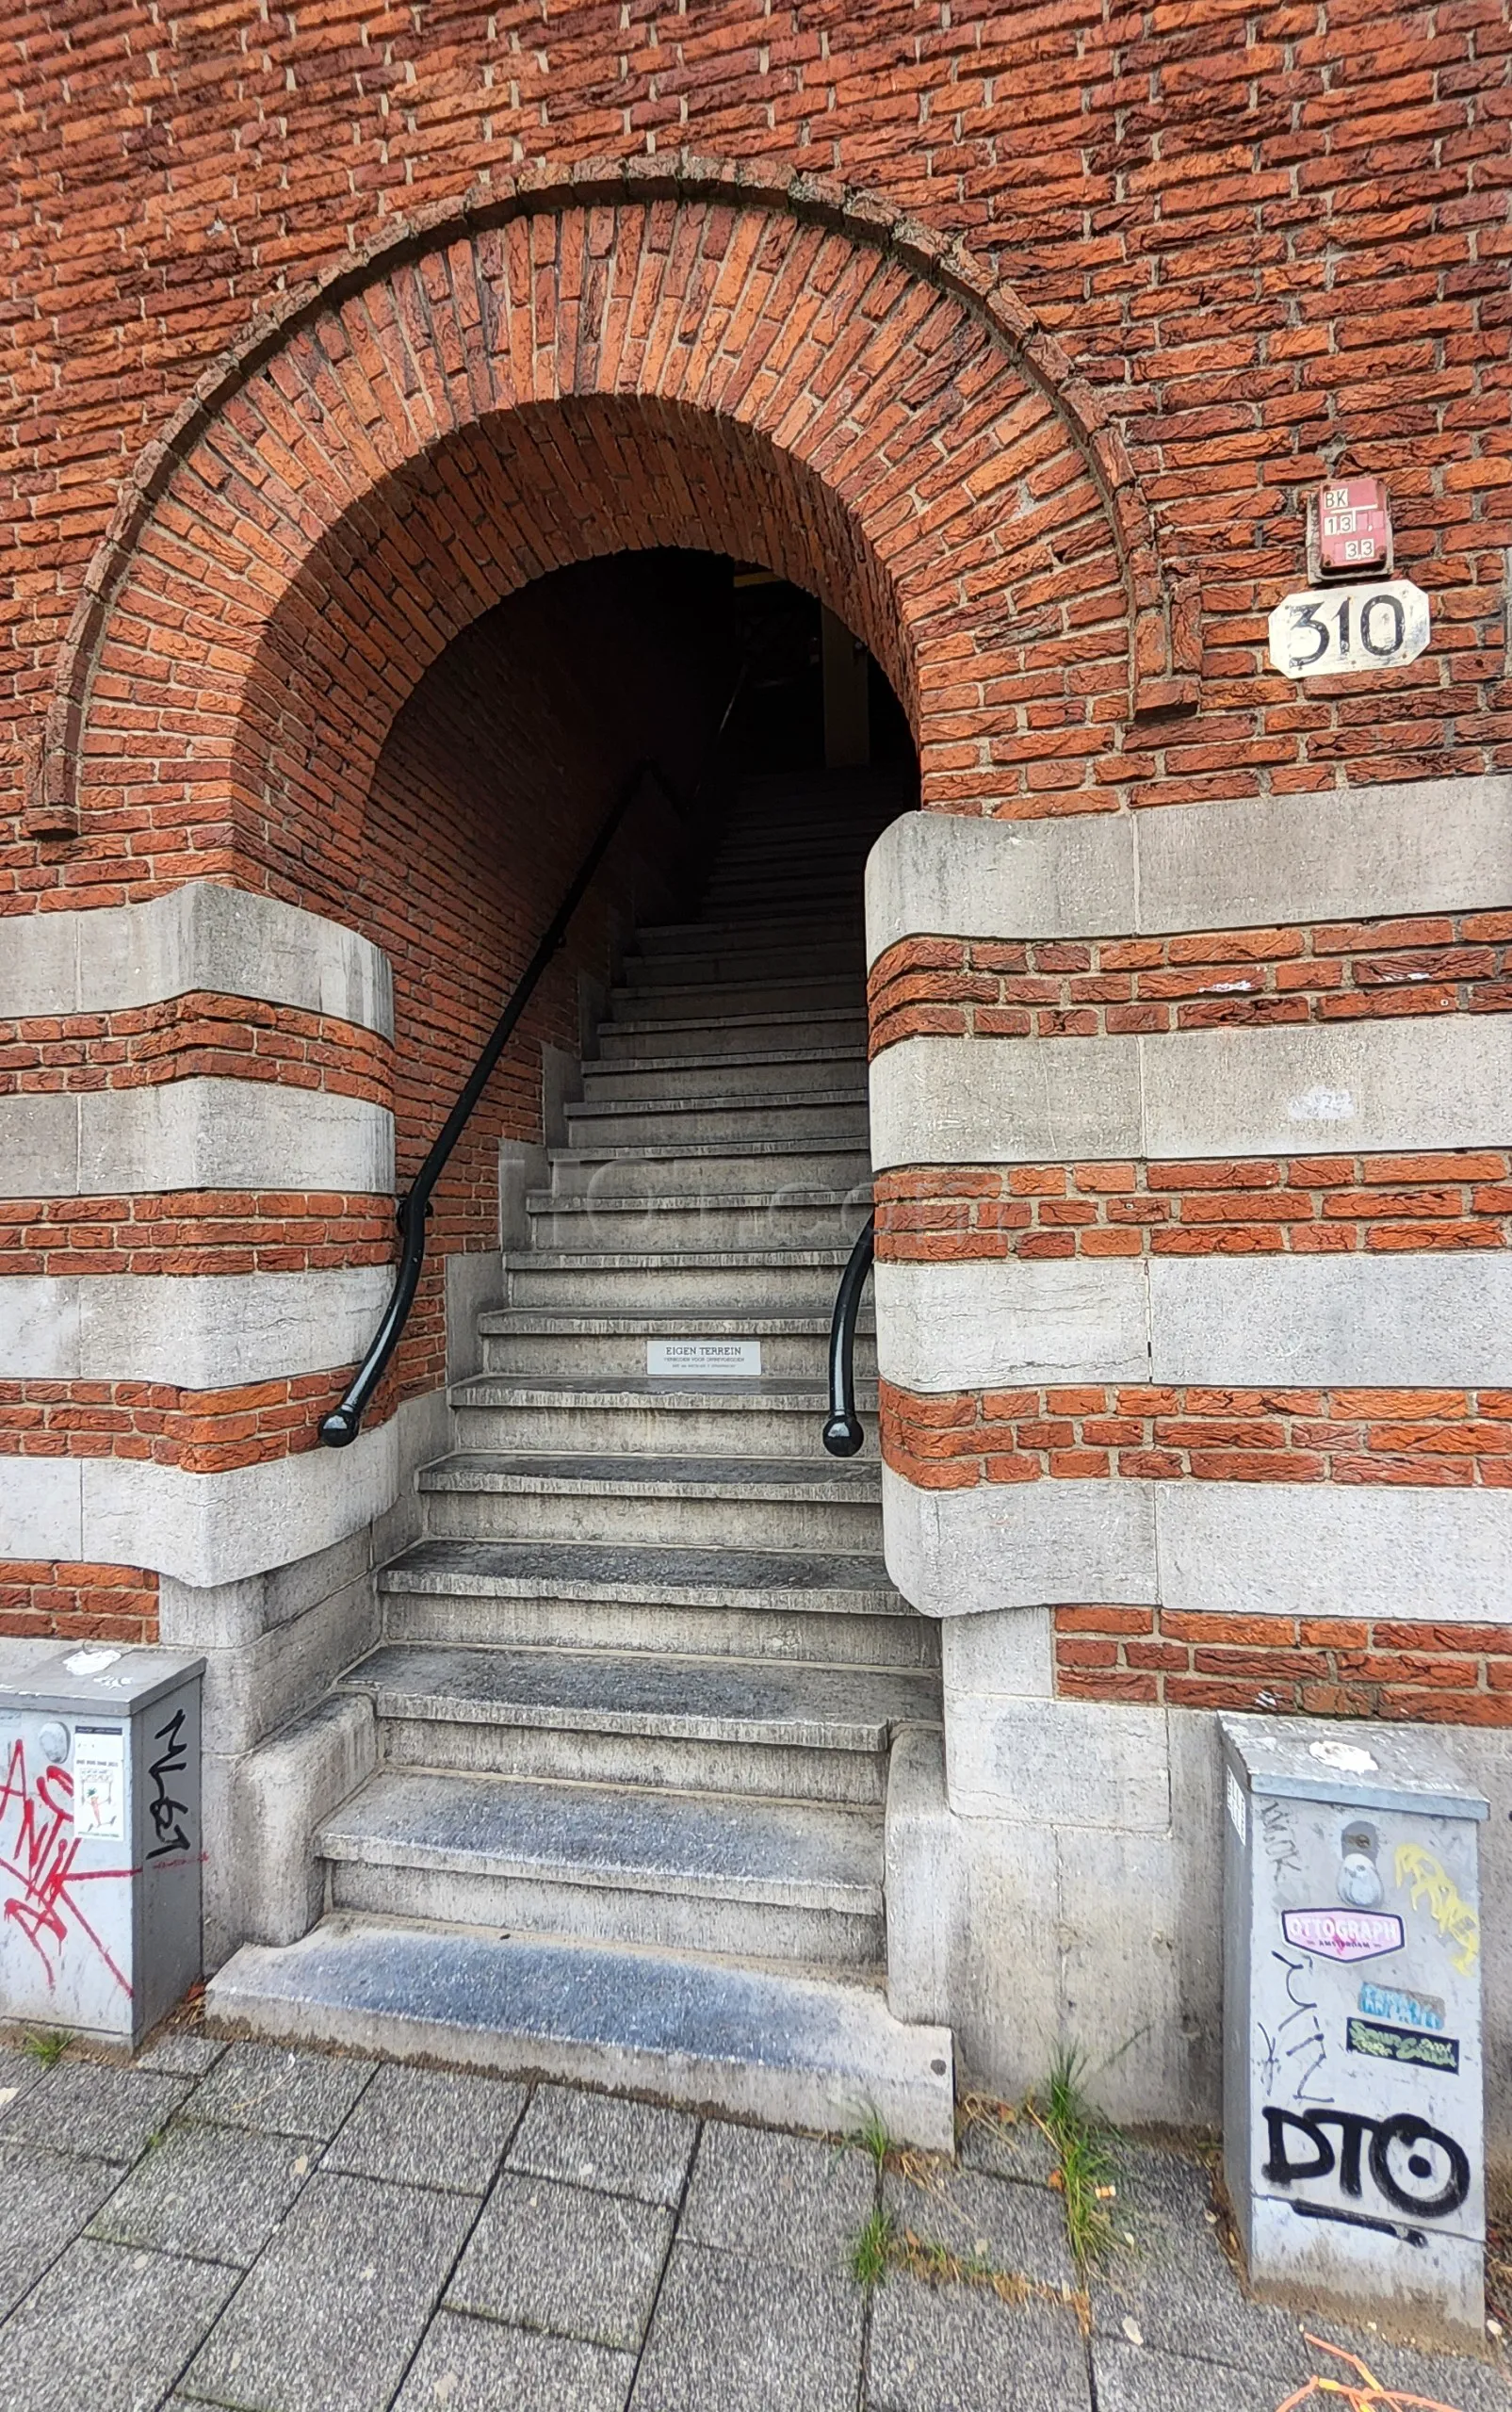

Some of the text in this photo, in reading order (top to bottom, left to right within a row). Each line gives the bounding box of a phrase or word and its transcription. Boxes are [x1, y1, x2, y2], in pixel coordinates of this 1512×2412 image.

[1325, 490, 1346, 508] BK
[1288, 594, 1406, 668] 310
[665, 1346, 741, 1356] EIGEN TERREIN
[1289, 1916, 1398, 1941] OTTOGRAPH
[1261, 2106, 1471, 2218] DTO
